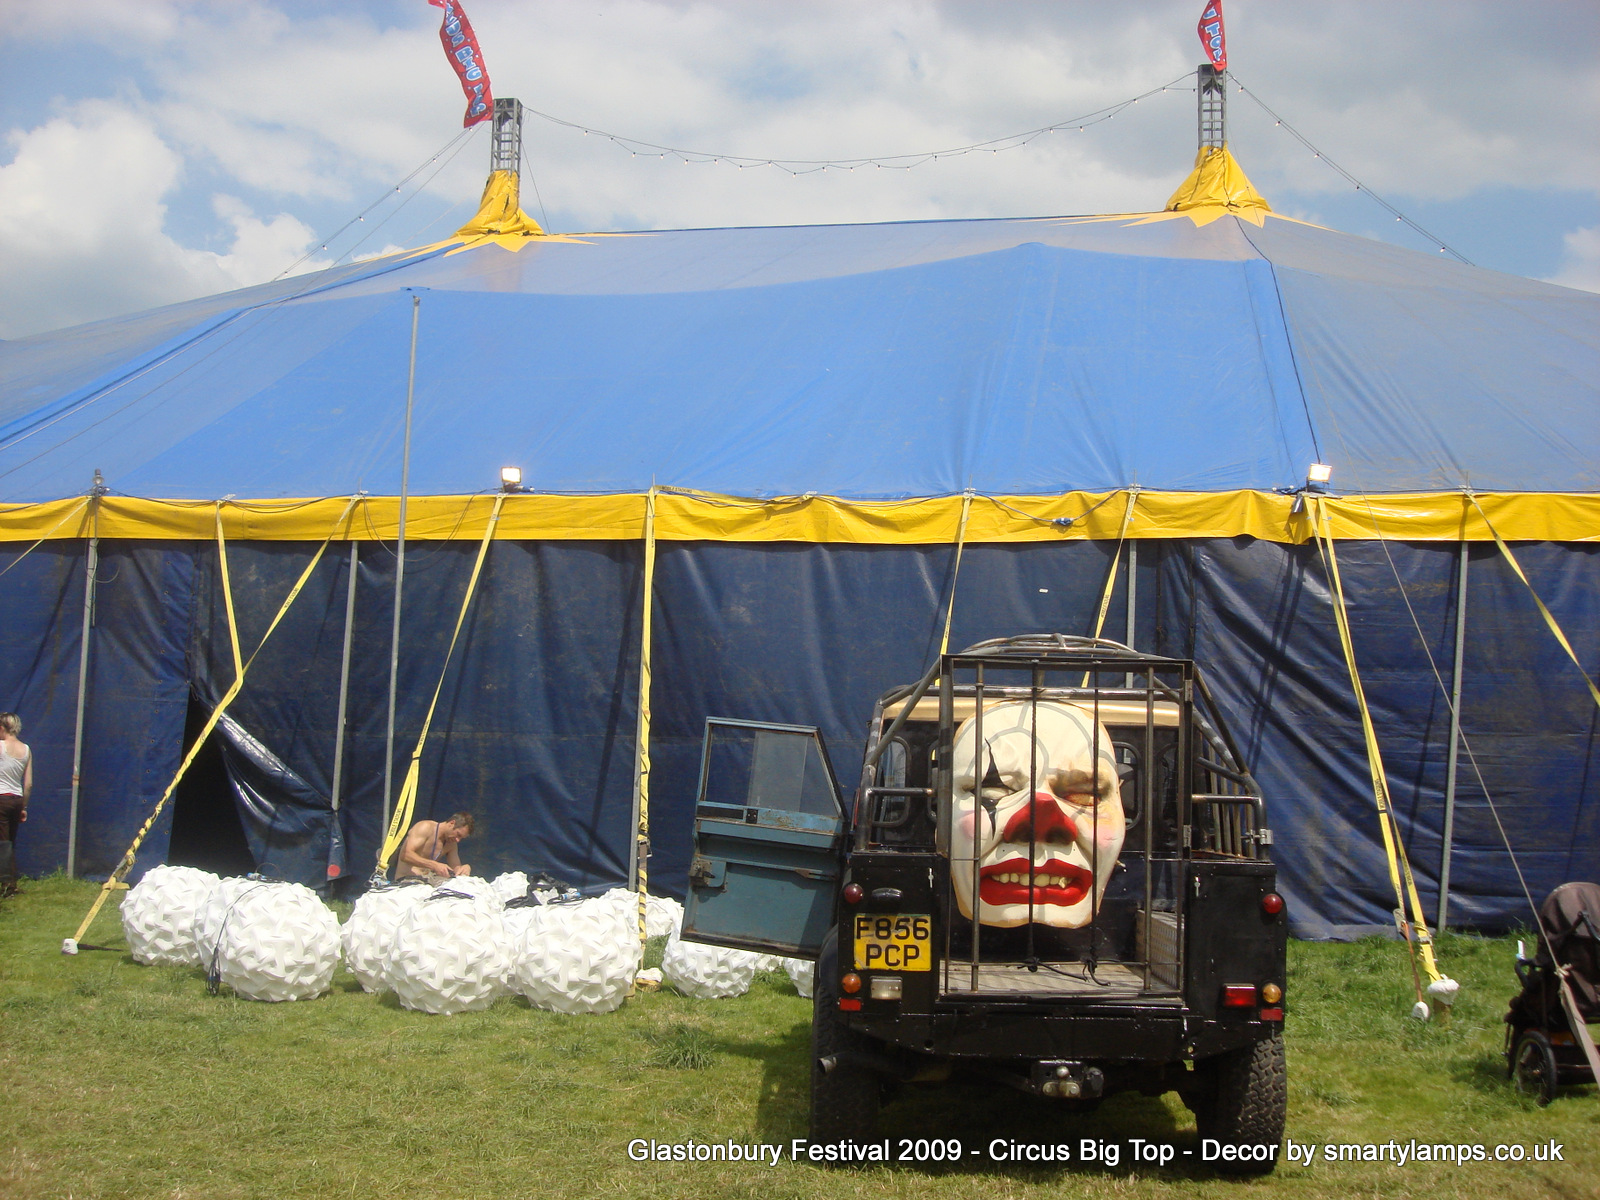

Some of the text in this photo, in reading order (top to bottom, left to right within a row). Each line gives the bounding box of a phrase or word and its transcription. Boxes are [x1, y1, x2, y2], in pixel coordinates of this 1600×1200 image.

[455, 46, 482, 81] BIG
[856, 917, 929, 940] F856
[865, 943, 920, 967] PCP
